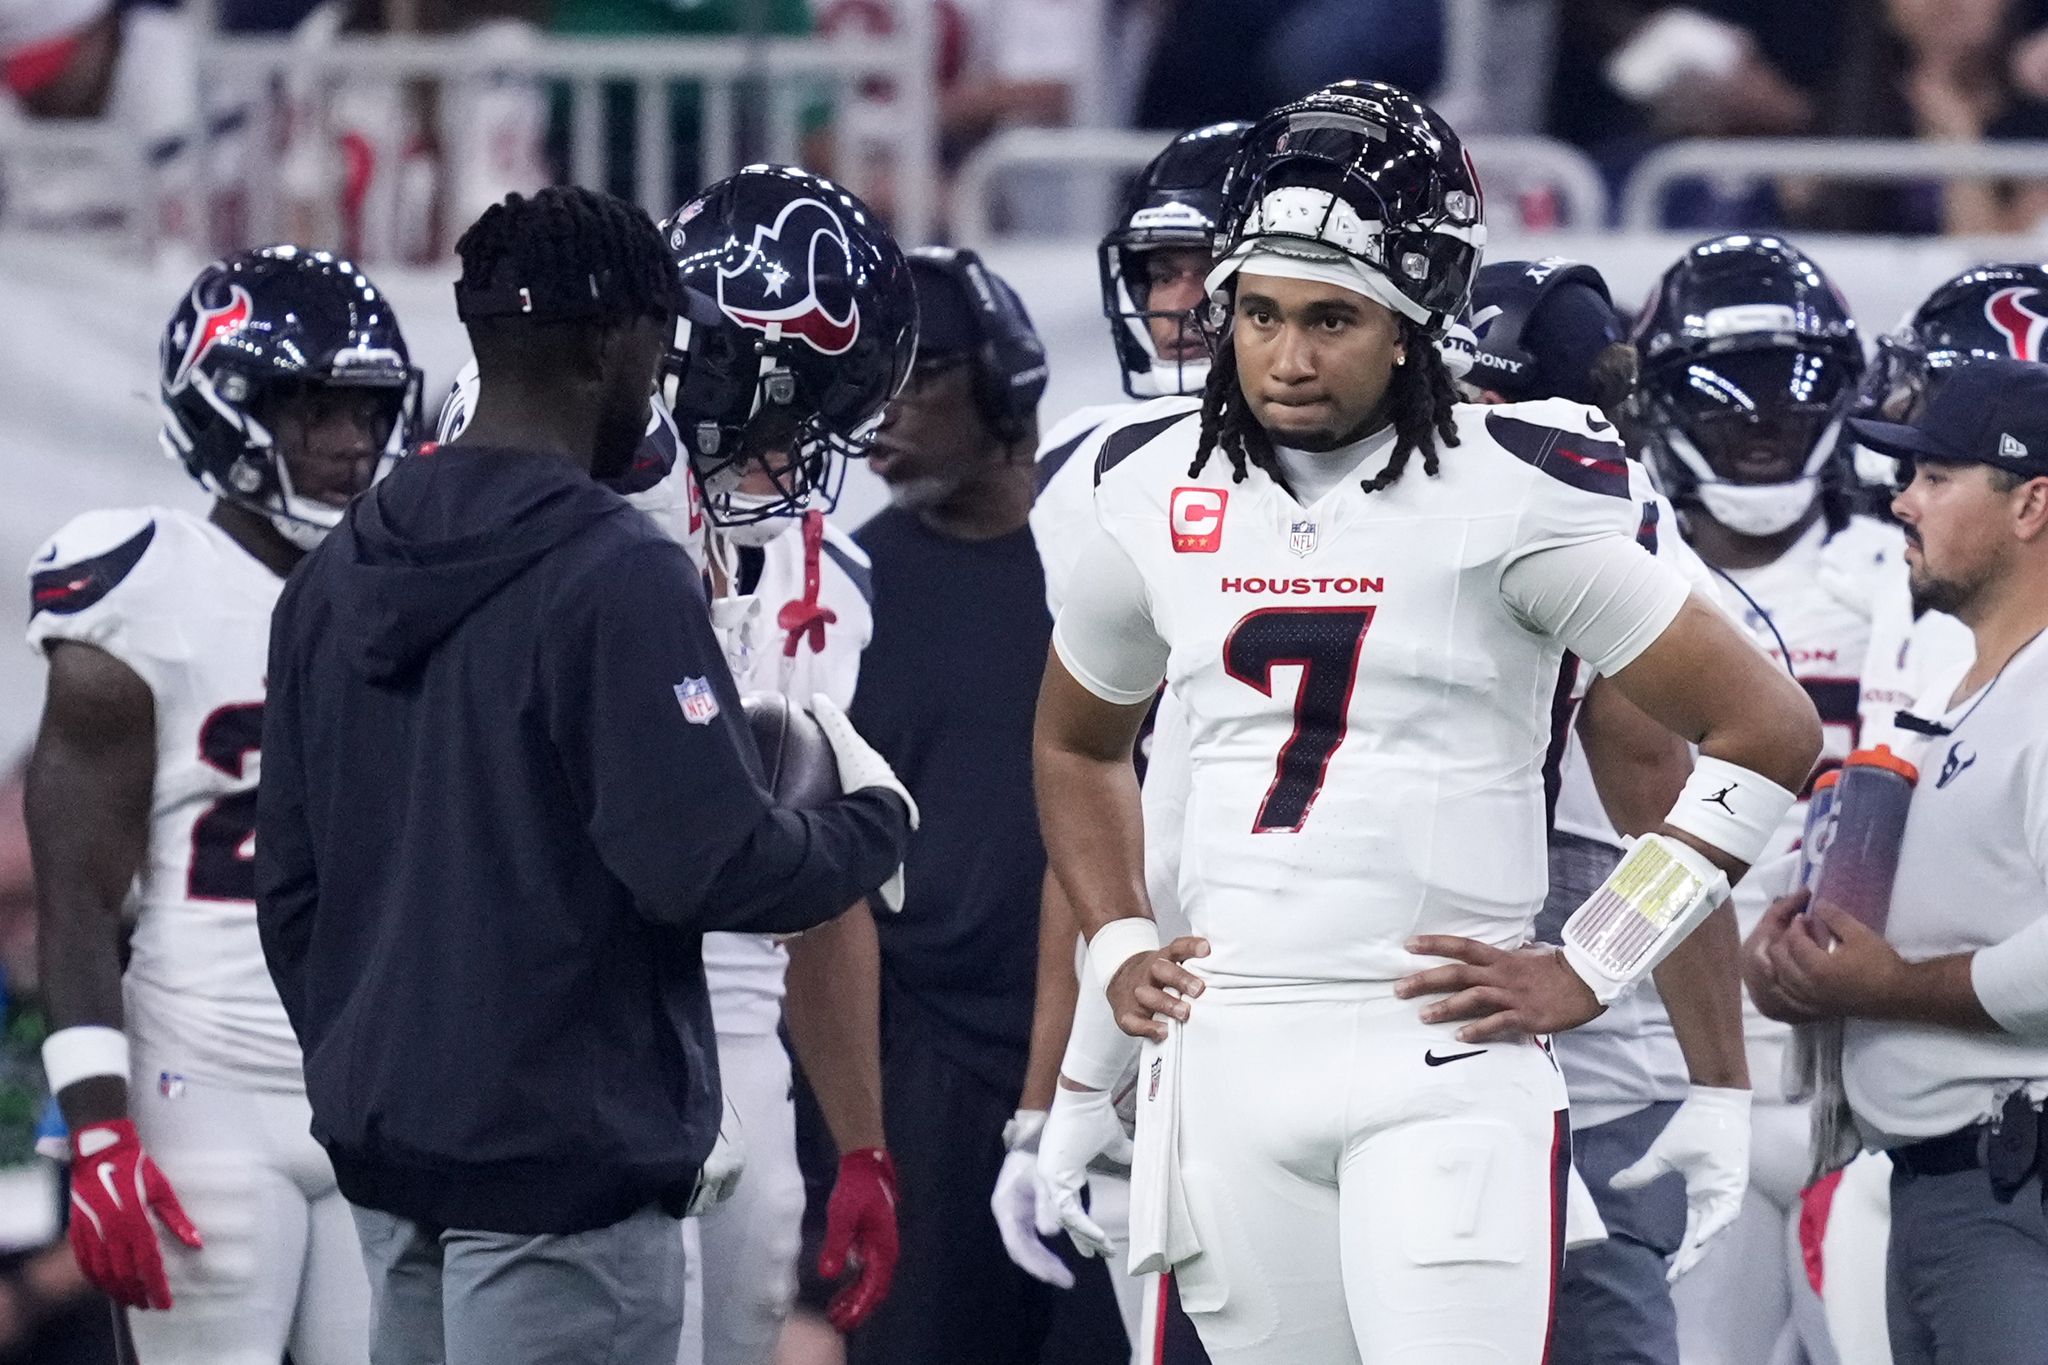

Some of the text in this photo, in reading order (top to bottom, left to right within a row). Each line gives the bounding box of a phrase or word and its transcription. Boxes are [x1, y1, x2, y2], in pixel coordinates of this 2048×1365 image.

[1473, 350, 1524, 374] SONY
[1172, 490, 1222, 536] C
[1292, 534, 1313, 549] NFL
[1221, 577, 1384, 594] HOUSTON
[685, 695, 715, 717] NFL
[1222, 605, 1377, 834] 7
